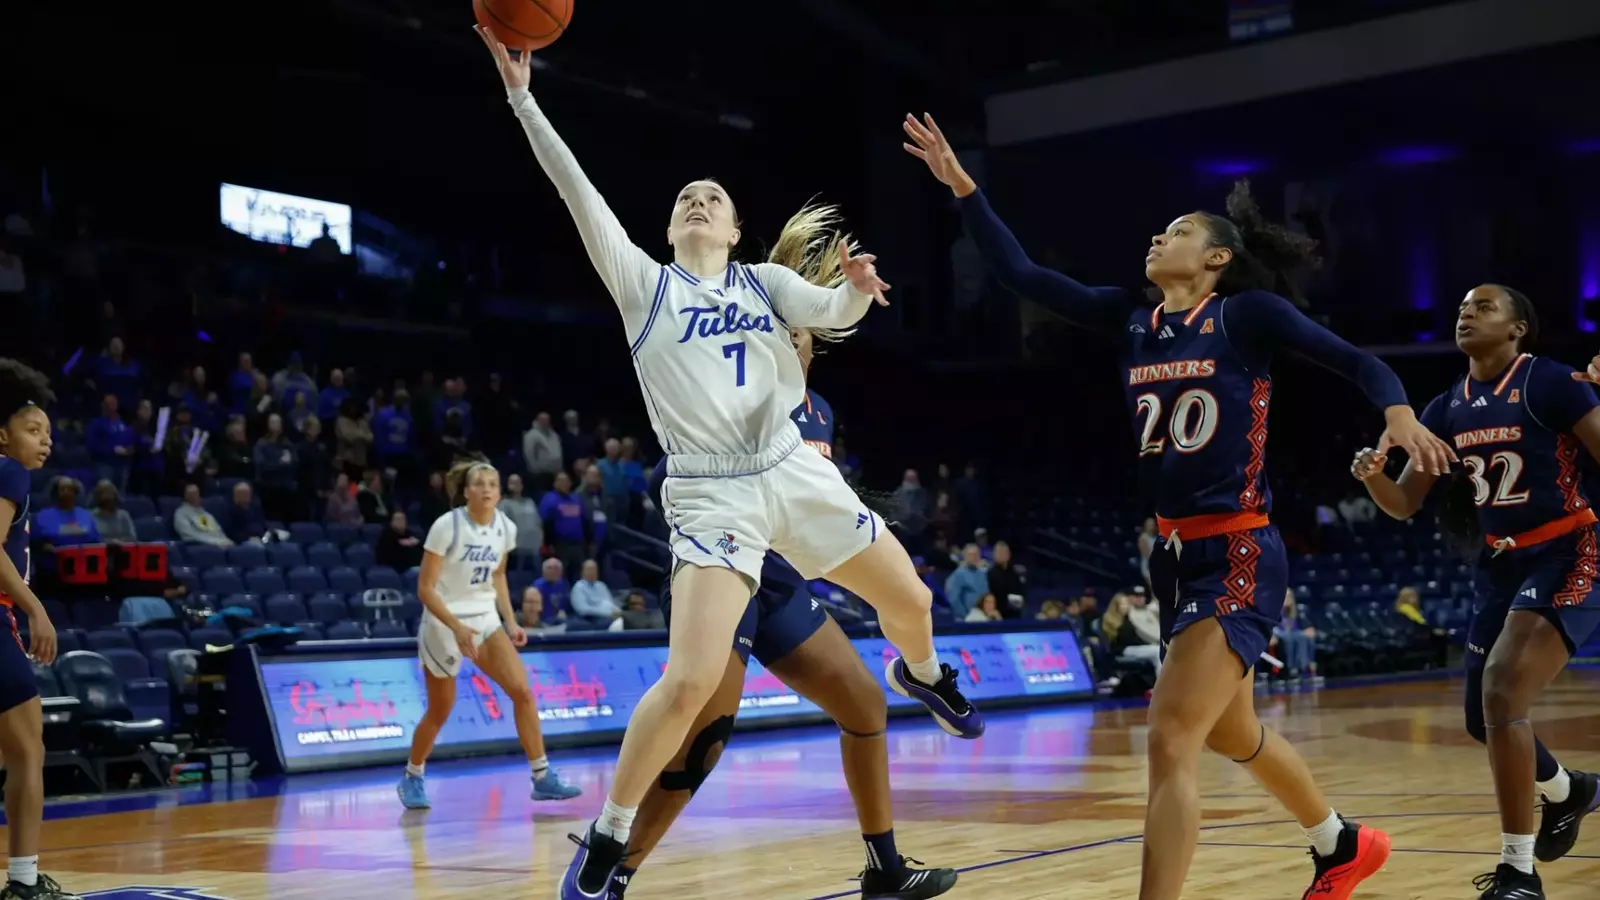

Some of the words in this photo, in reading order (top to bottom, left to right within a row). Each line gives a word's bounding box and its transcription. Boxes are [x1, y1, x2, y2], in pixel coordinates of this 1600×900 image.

[677, 302, 774, 343] Tulsa
[722, 341, 746, 387] 7
[1128, 359, 1216, 386] RUNNERS
[1136, 388, 1219, 456] 20
[1461, 451, 1531, 507] 32
[715, 537, 740, 552] Tulsa
[470, 566, 490, 586] 21
